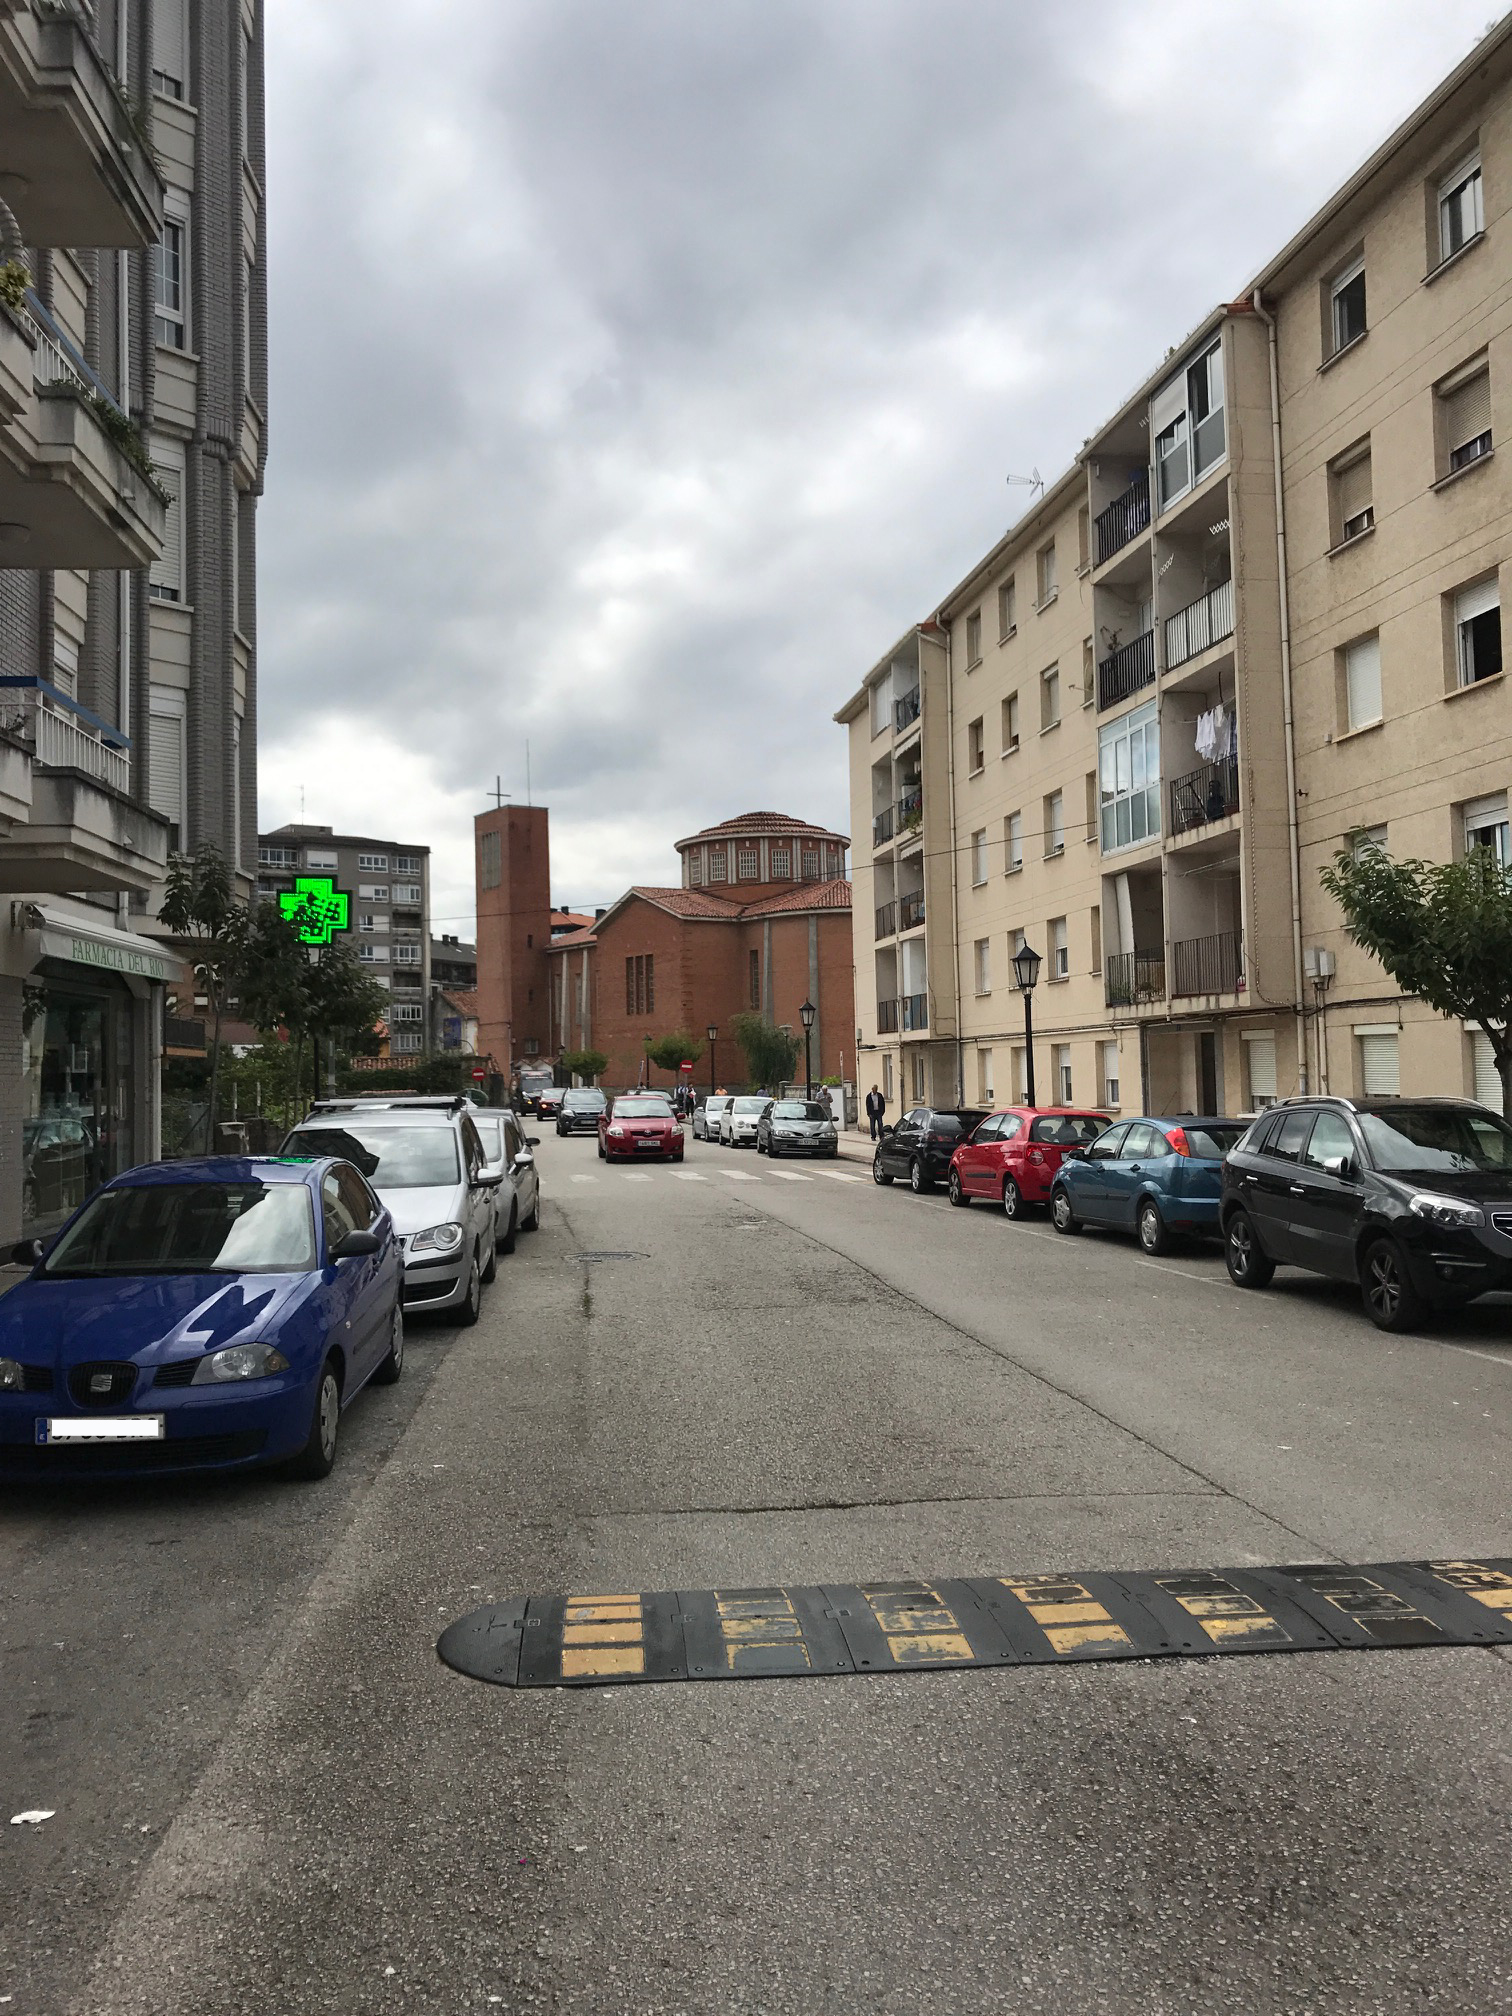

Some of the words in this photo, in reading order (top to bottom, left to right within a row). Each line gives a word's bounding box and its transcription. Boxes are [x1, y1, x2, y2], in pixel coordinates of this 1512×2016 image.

[71, 939, 124, 969] FARMACIA
[128, 952, 147, 973] DEL
[150, 957, 164, 977] RIO
